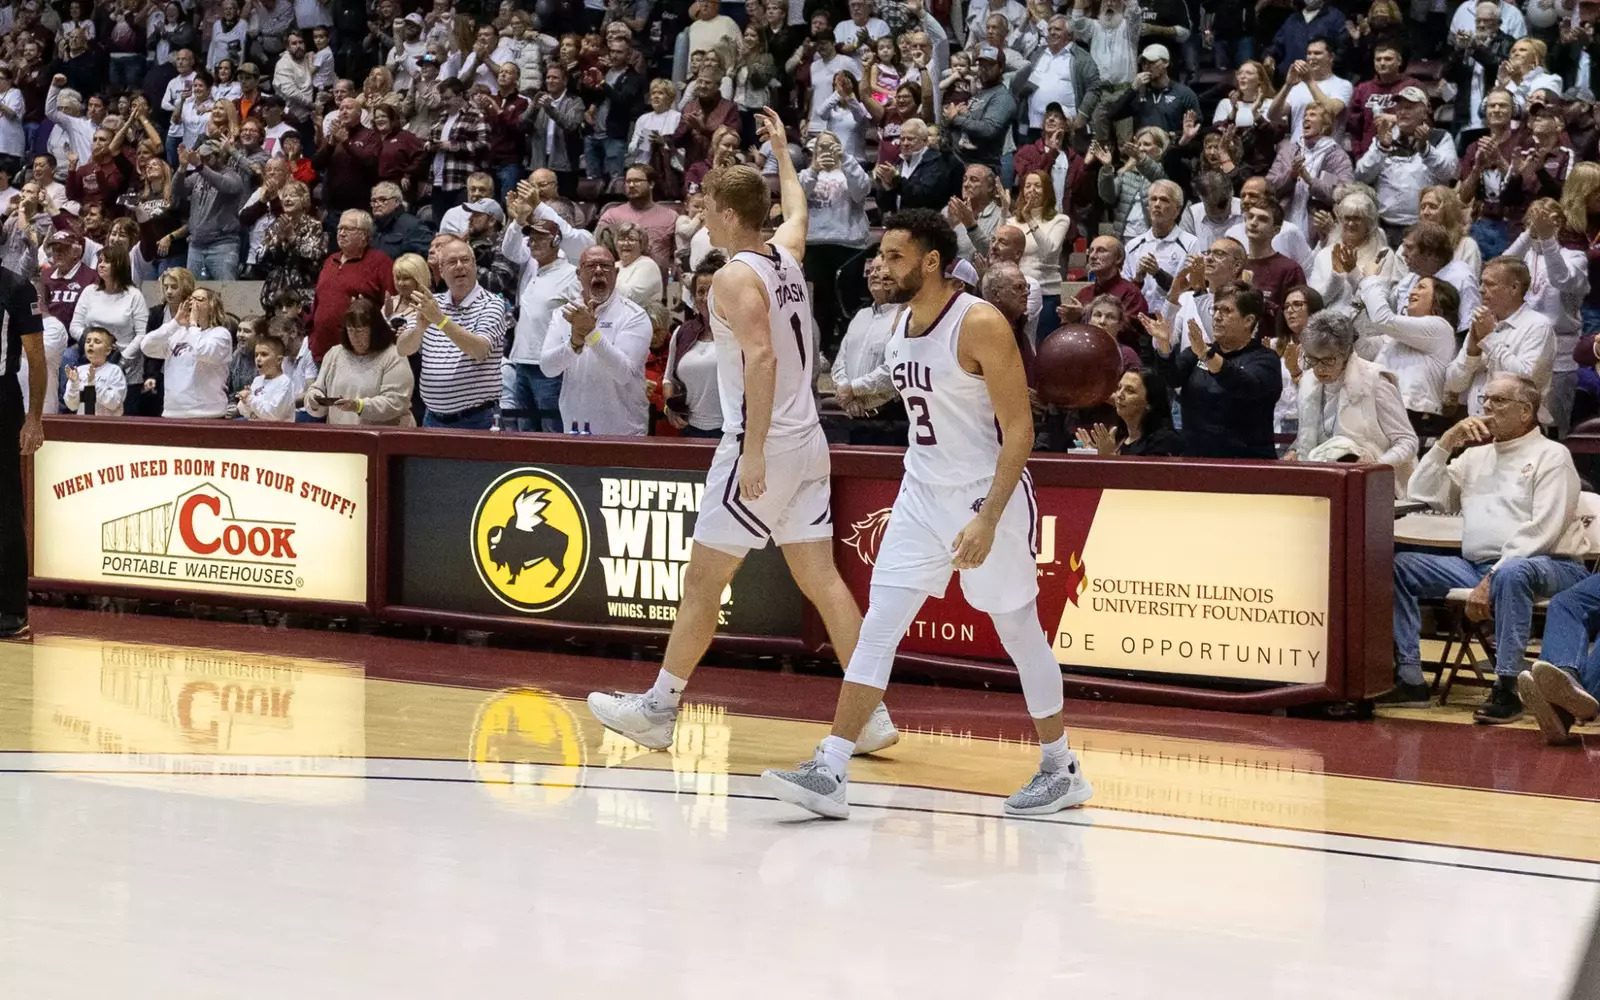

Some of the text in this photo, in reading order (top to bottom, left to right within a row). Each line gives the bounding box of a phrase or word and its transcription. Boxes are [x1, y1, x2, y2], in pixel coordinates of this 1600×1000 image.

[51, 290, 78, 302] IU
[790, 311, 806, 371] 1
[893, 361, 933, 392] SIU
[907, 396, 937, 445] 3
[53, 459, 356, 519] WHEN YOU NEED ROOM FOR YOUR STUFF!
[600, 507, 694, 561] WIL
[102, 557, 293, 585] PORTABLE WAREHOUSES
[1093, 579, 1273, 604] SOUTHERN ILLINOIS
[607, 602, 646, 619] WINGS.
[1093, 597, 1325, 627] UNIVERSITY FOUNDATION
[1121, 636, 1320, 668] OPPORTUNITY
